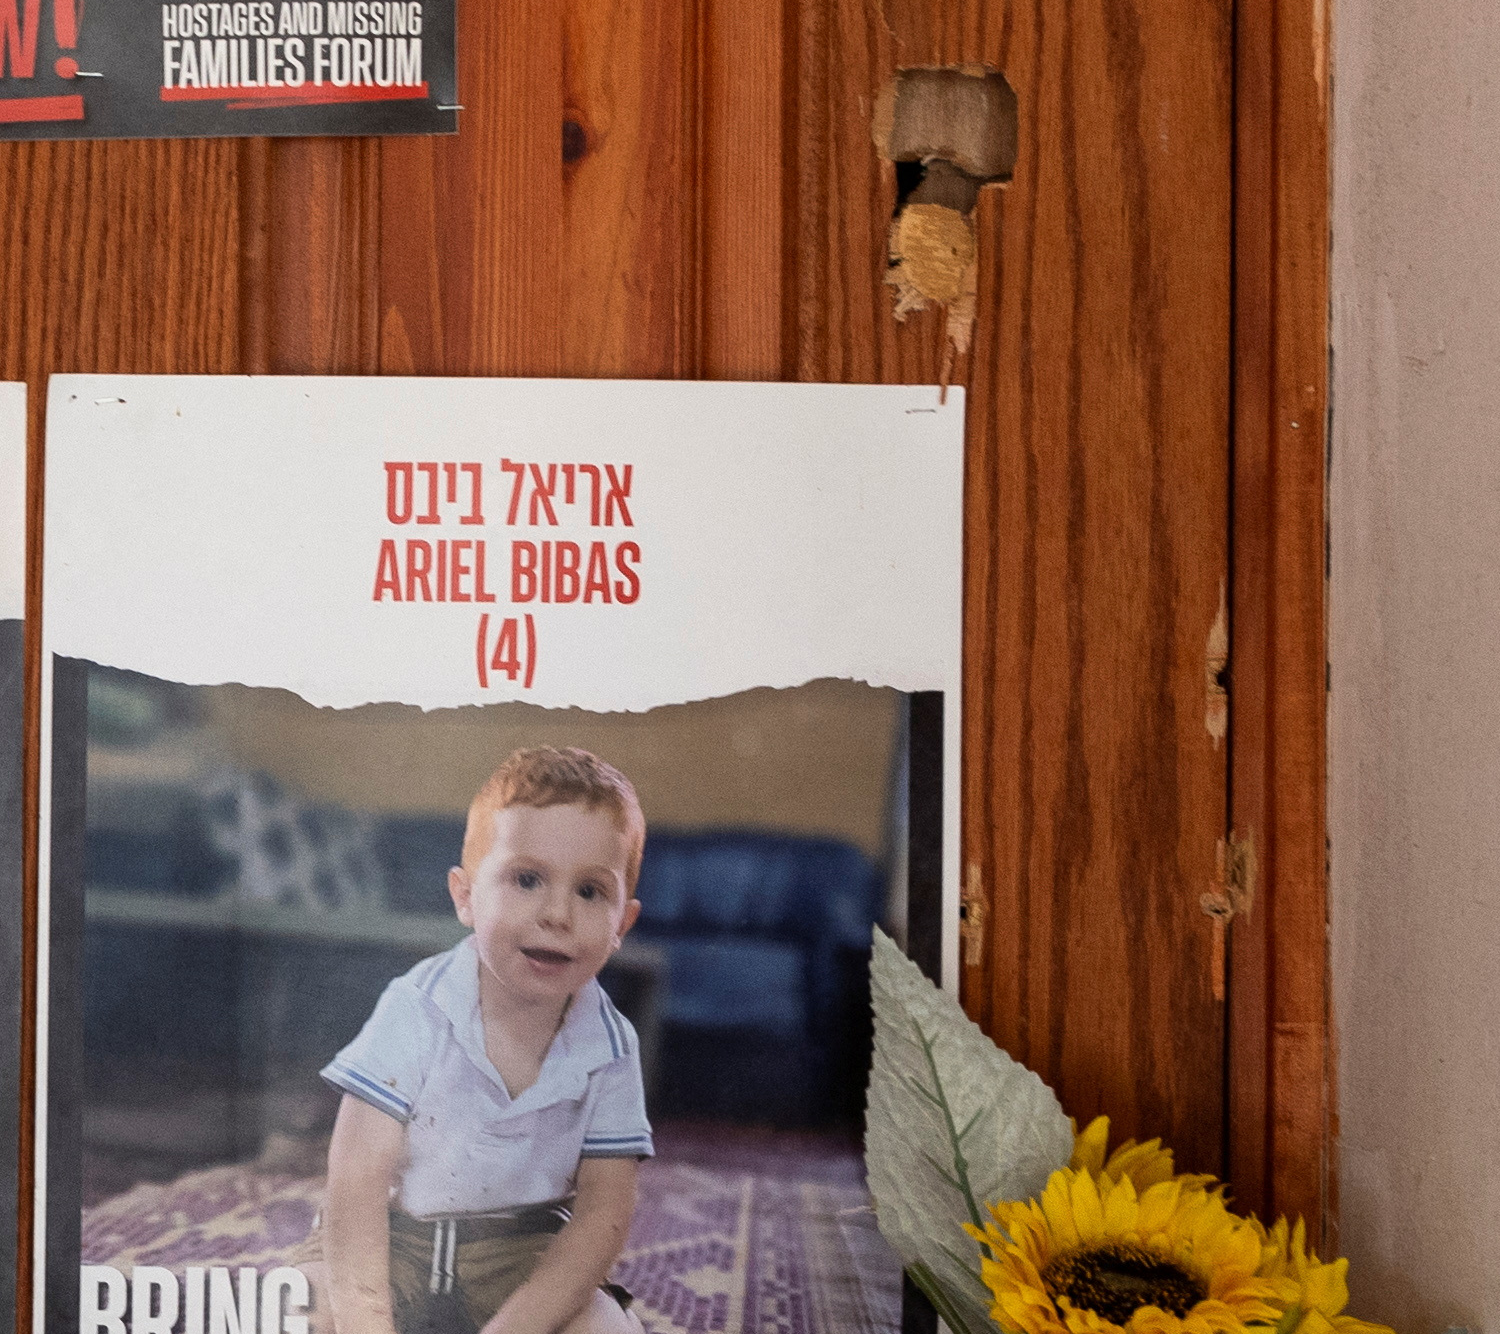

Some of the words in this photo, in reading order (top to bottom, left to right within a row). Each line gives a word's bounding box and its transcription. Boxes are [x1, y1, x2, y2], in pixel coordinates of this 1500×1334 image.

[162, 1, 275, 38] HOSTAGES
[278, 1, 323, 36] AND
[327, 1, 422, 36] MISSING
[163, 37, 306, 89] FAMILIES
[313, 37, 422, 87] FORUM
[383, 461, 485, 526] ביבס
[500, 457, 635, 527] אריאל
[372, 538, 497, 604] ARIEL
[511, 540, 642, 605] BIBAS
[476, 613, 537, 689] (4)
